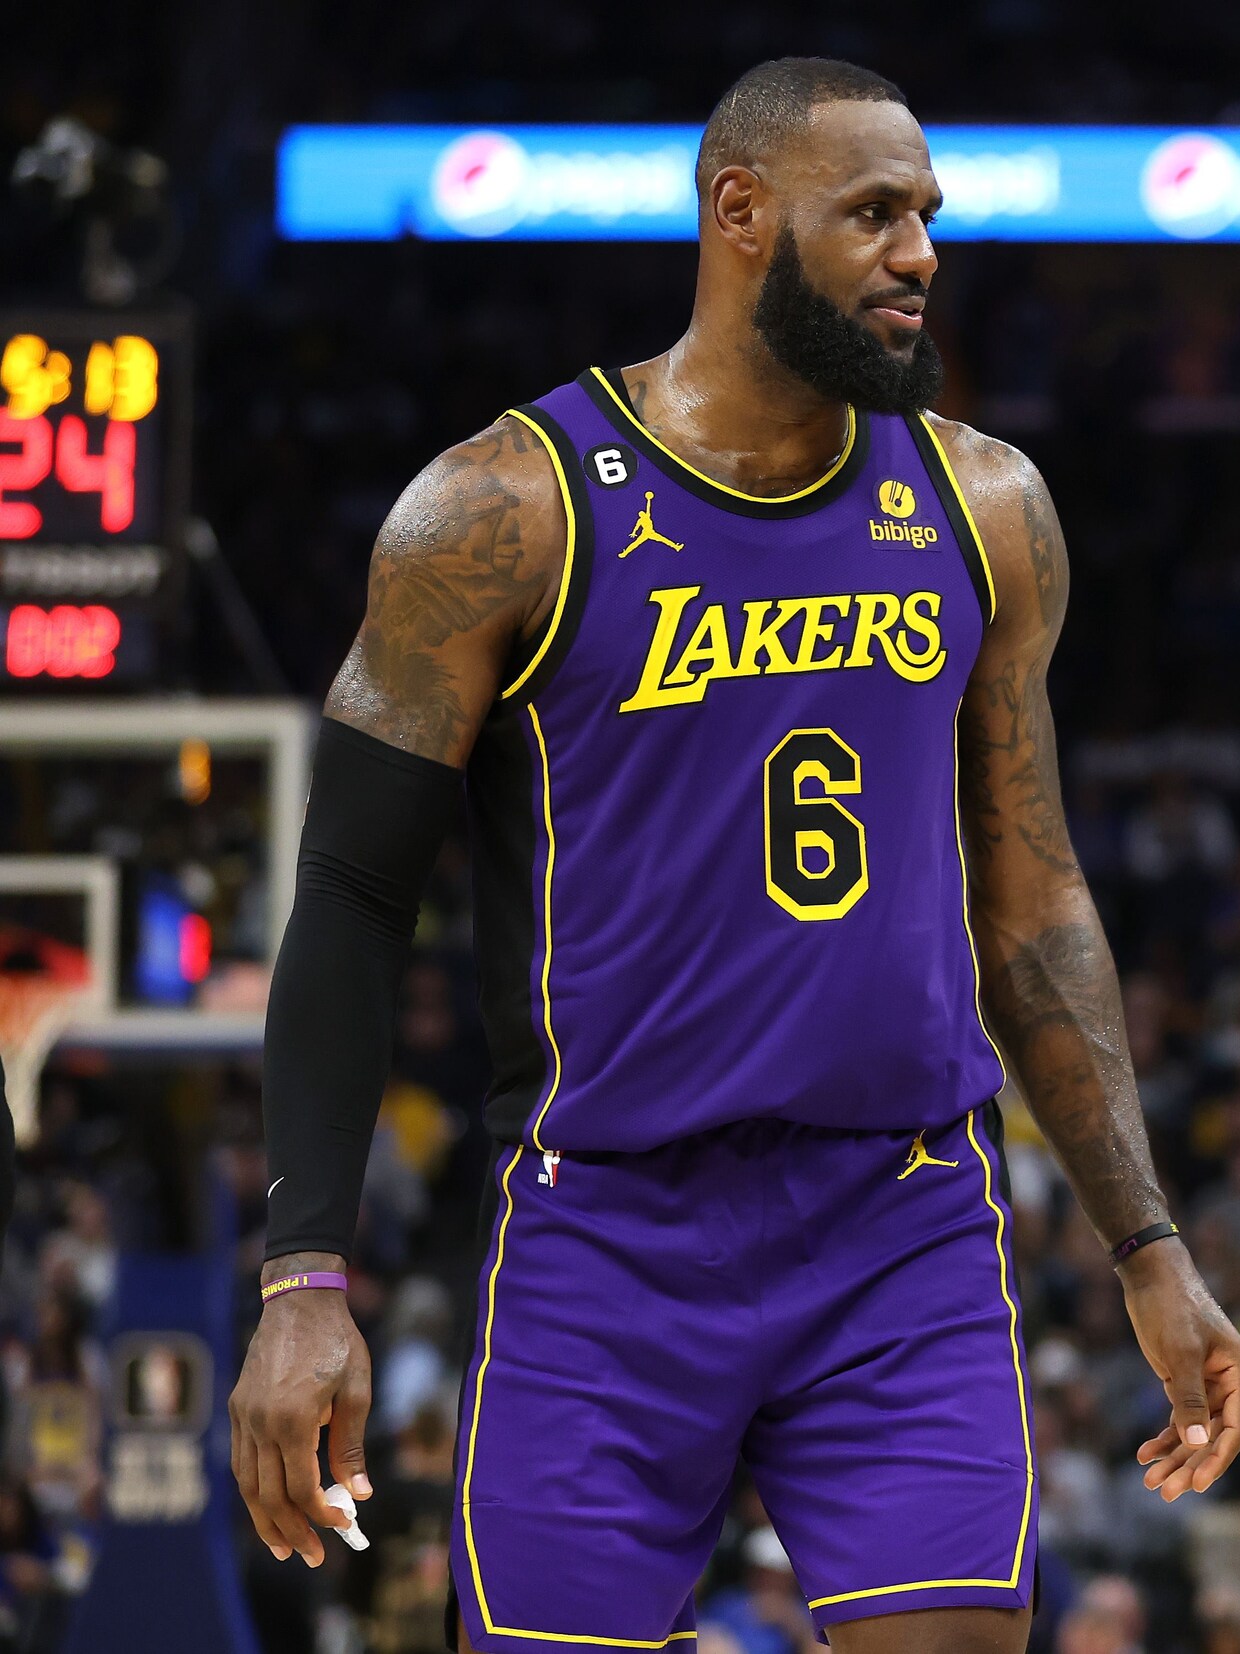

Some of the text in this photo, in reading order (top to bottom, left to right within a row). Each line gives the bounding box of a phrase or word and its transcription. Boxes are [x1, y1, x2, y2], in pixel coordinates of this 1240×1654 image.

[0, 405, 136, 540] 24
[594, 448, 628, 485] 6
[868, 518, 939, 549] bibigo
[617, 583, 948, 715] LAKERS
[763, 727, 870, 922] 6
